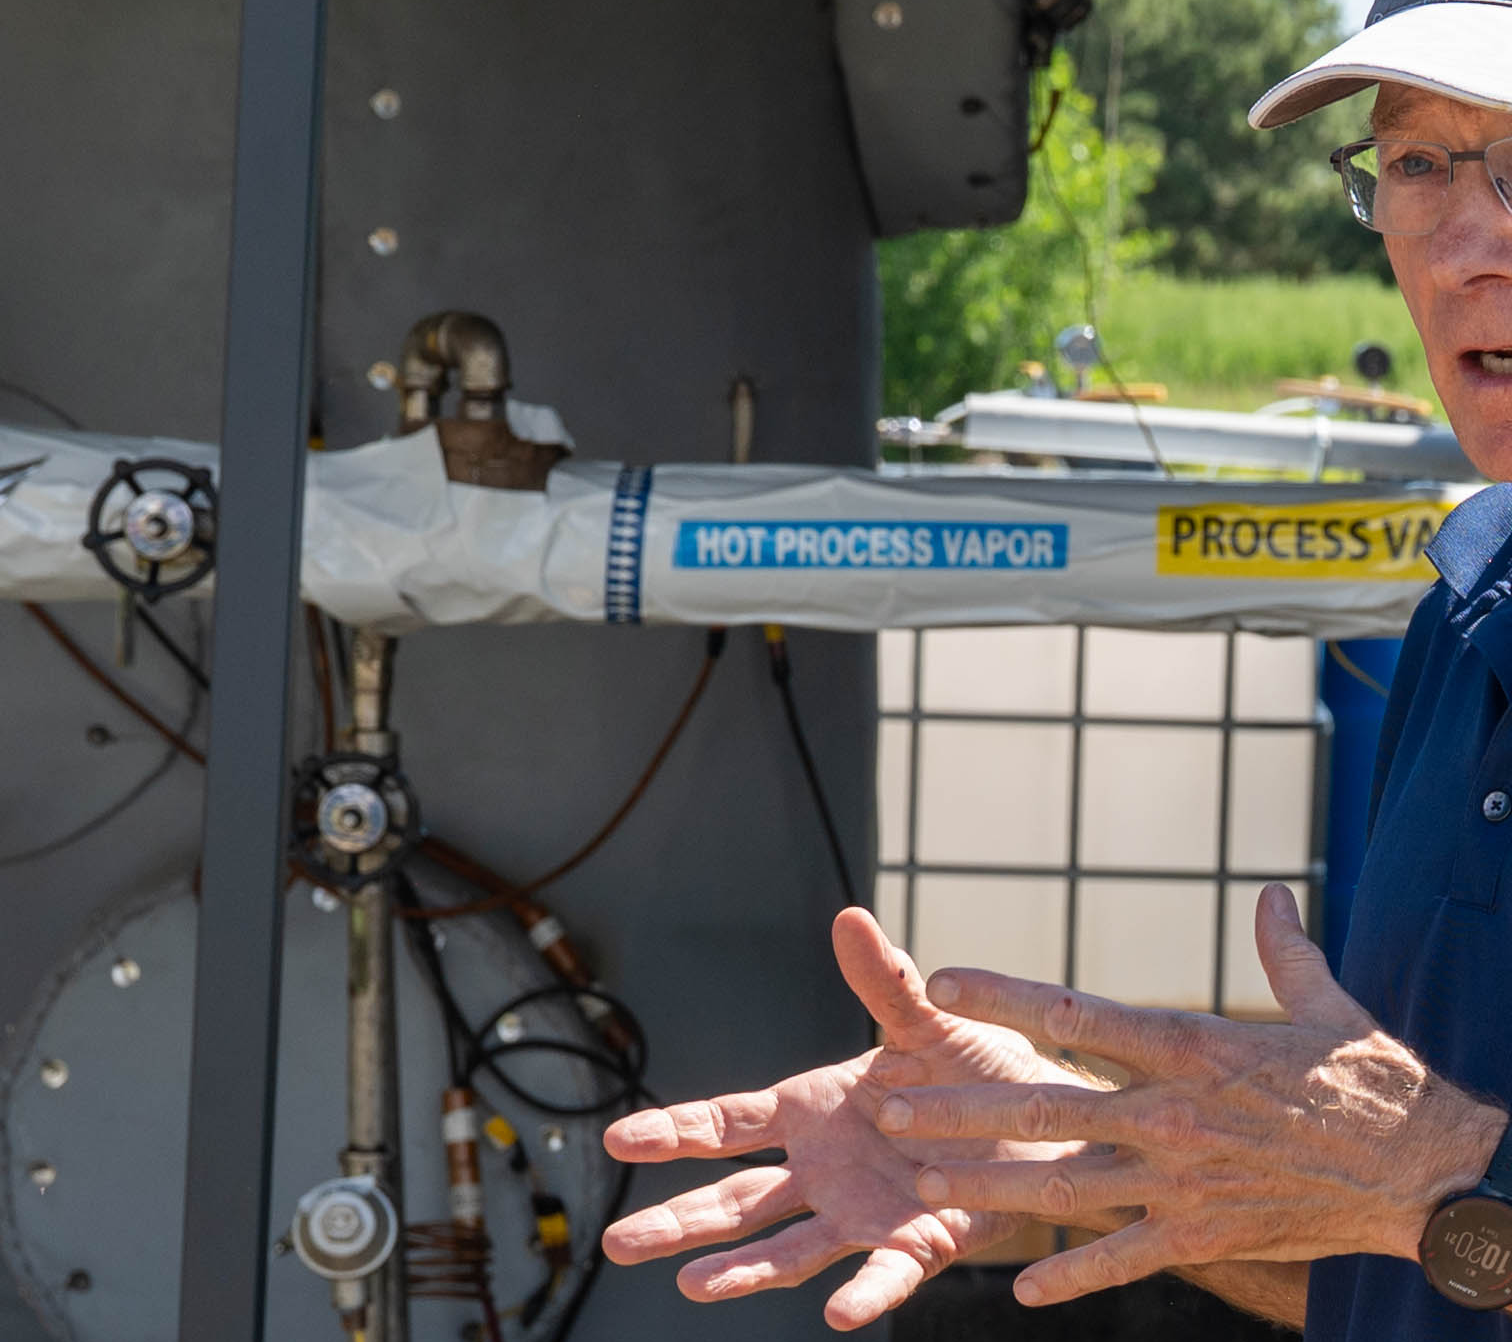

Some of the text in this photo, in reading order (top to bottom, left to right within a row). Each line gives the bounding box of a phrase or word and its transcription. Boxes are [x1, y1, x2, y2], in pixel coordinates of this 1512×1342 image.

[695, 526, 1055, 567] HOT PROCESS VAPOR
[1171, 515, 1370, 561] PROCESS
